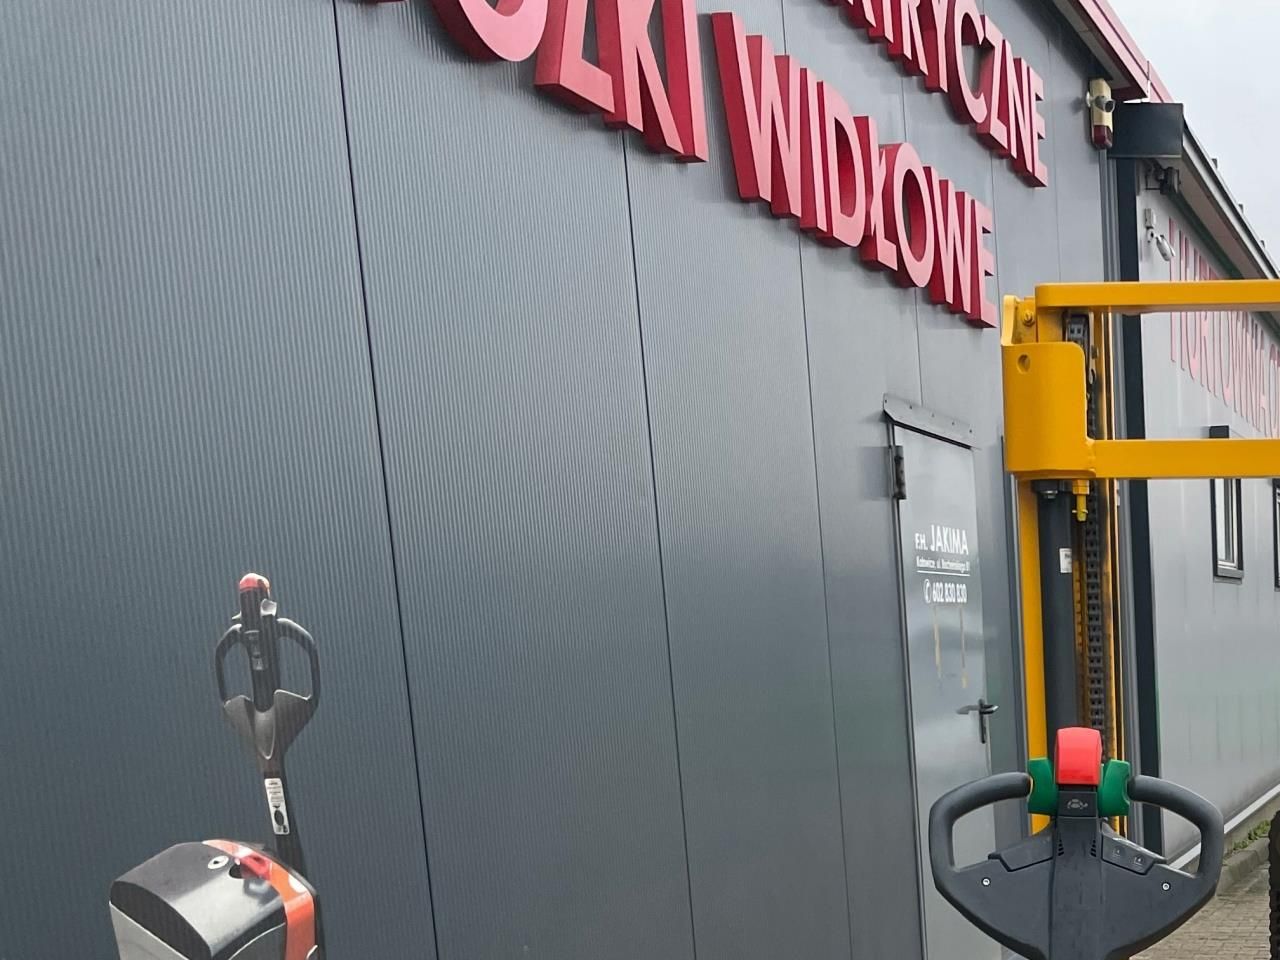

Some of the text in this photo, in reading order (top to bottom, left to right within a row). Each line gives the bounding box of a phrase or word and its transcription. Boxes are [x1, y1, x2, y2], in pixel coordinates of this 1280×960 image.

[712, 12, 997, 328] WIDŁOWE
[930, 524, 969, 555] JAKIMA
[932, 582, 944, 602] 602
